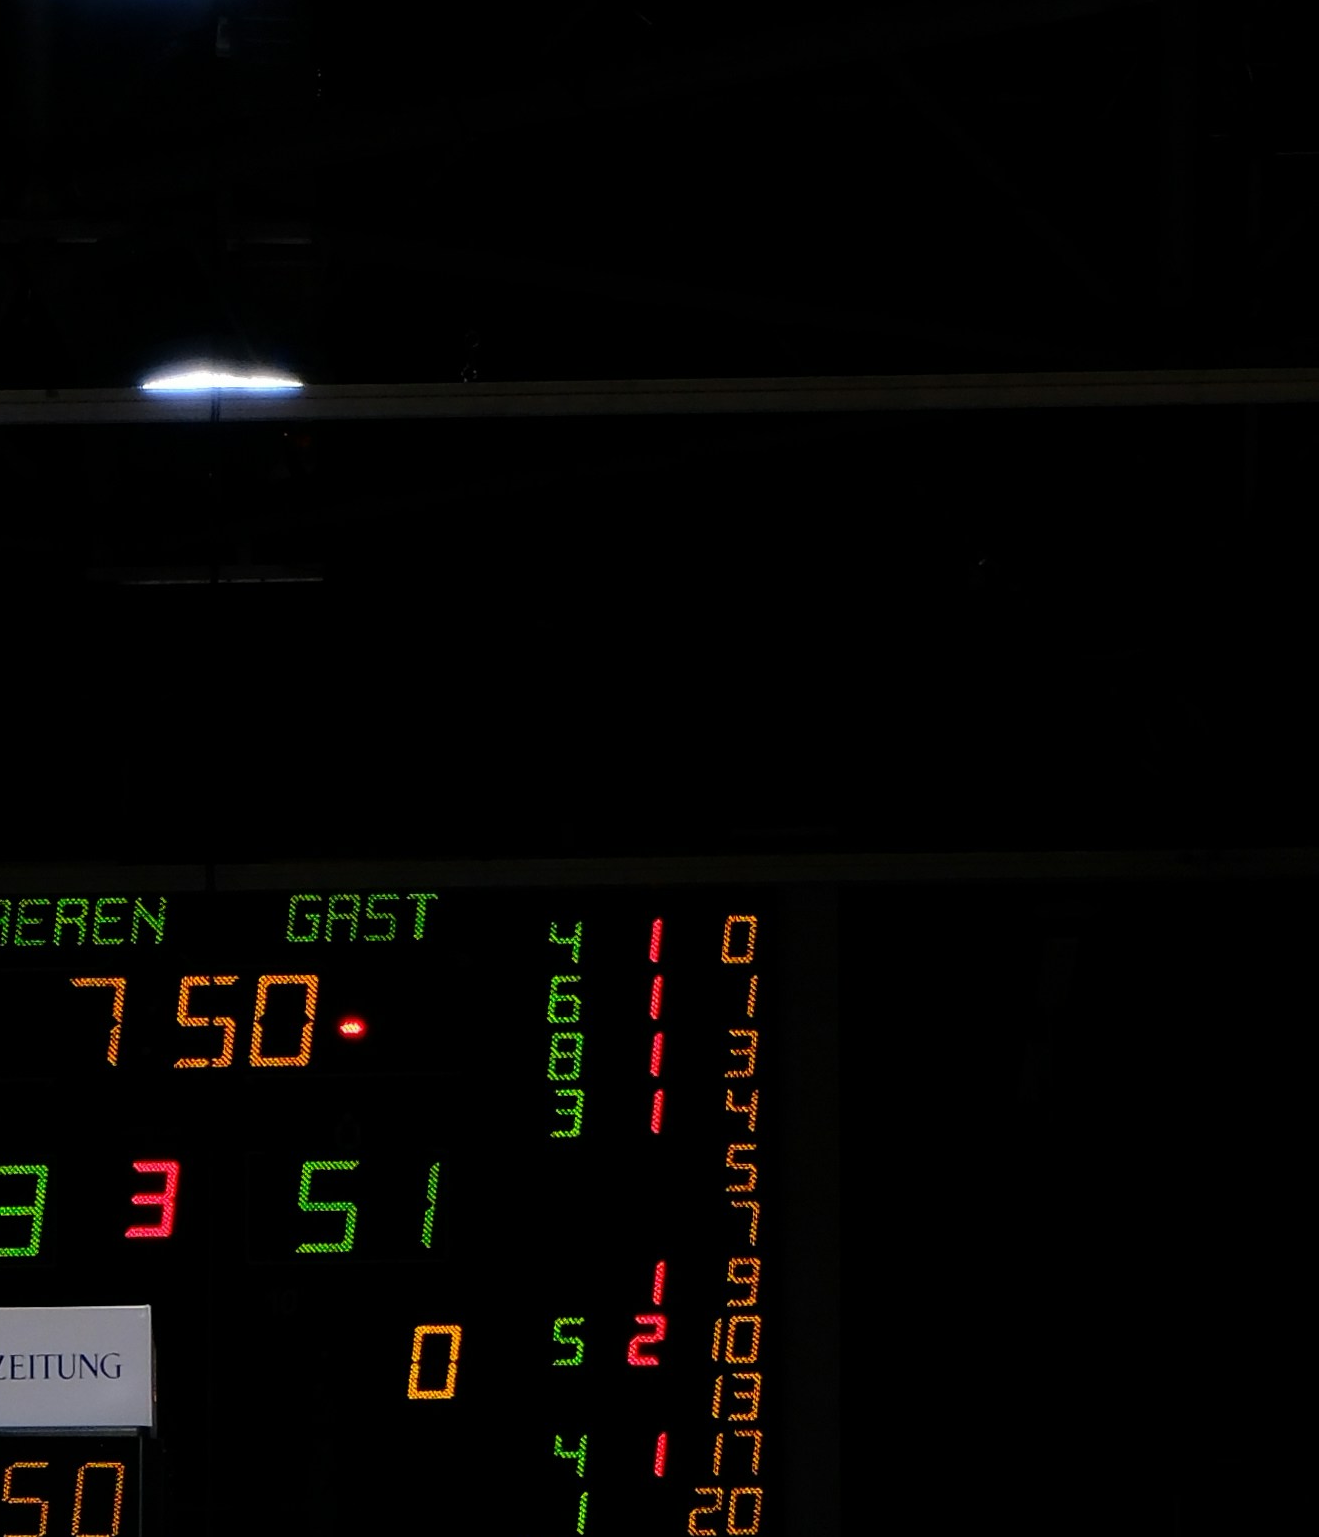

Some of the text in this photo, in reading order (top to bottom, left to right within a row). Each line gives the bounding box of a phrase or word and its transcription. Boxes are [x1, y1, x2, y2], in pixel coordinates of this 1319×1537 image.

[287, 893, 438, 943] GAST
[549, 922, 582, 963] 4
[649, 918, 663, 963] 1
[547, 975, 581, 1023] 6
[649, 975, 664, 1020] 1
[547, 1029, 758, 1080] 8 1 3
[551, 1089, 758, 1138] 3 1 4
[726, 1144, 757, 1192] 5
[125, 1159, 180, 1239] 3
[732, 1201, 760, 1244] 7
[652, 1257, 761, 1306] 1 9
[407, 1324, 462, 1399] 0
[553, 1313, 761, 1366] 5 2 10
[712, 1372, 762, 1421] 13
[554, 1430, 763, 1477] 4 1 17
[577, 1487, 763, 1536] 1 20
